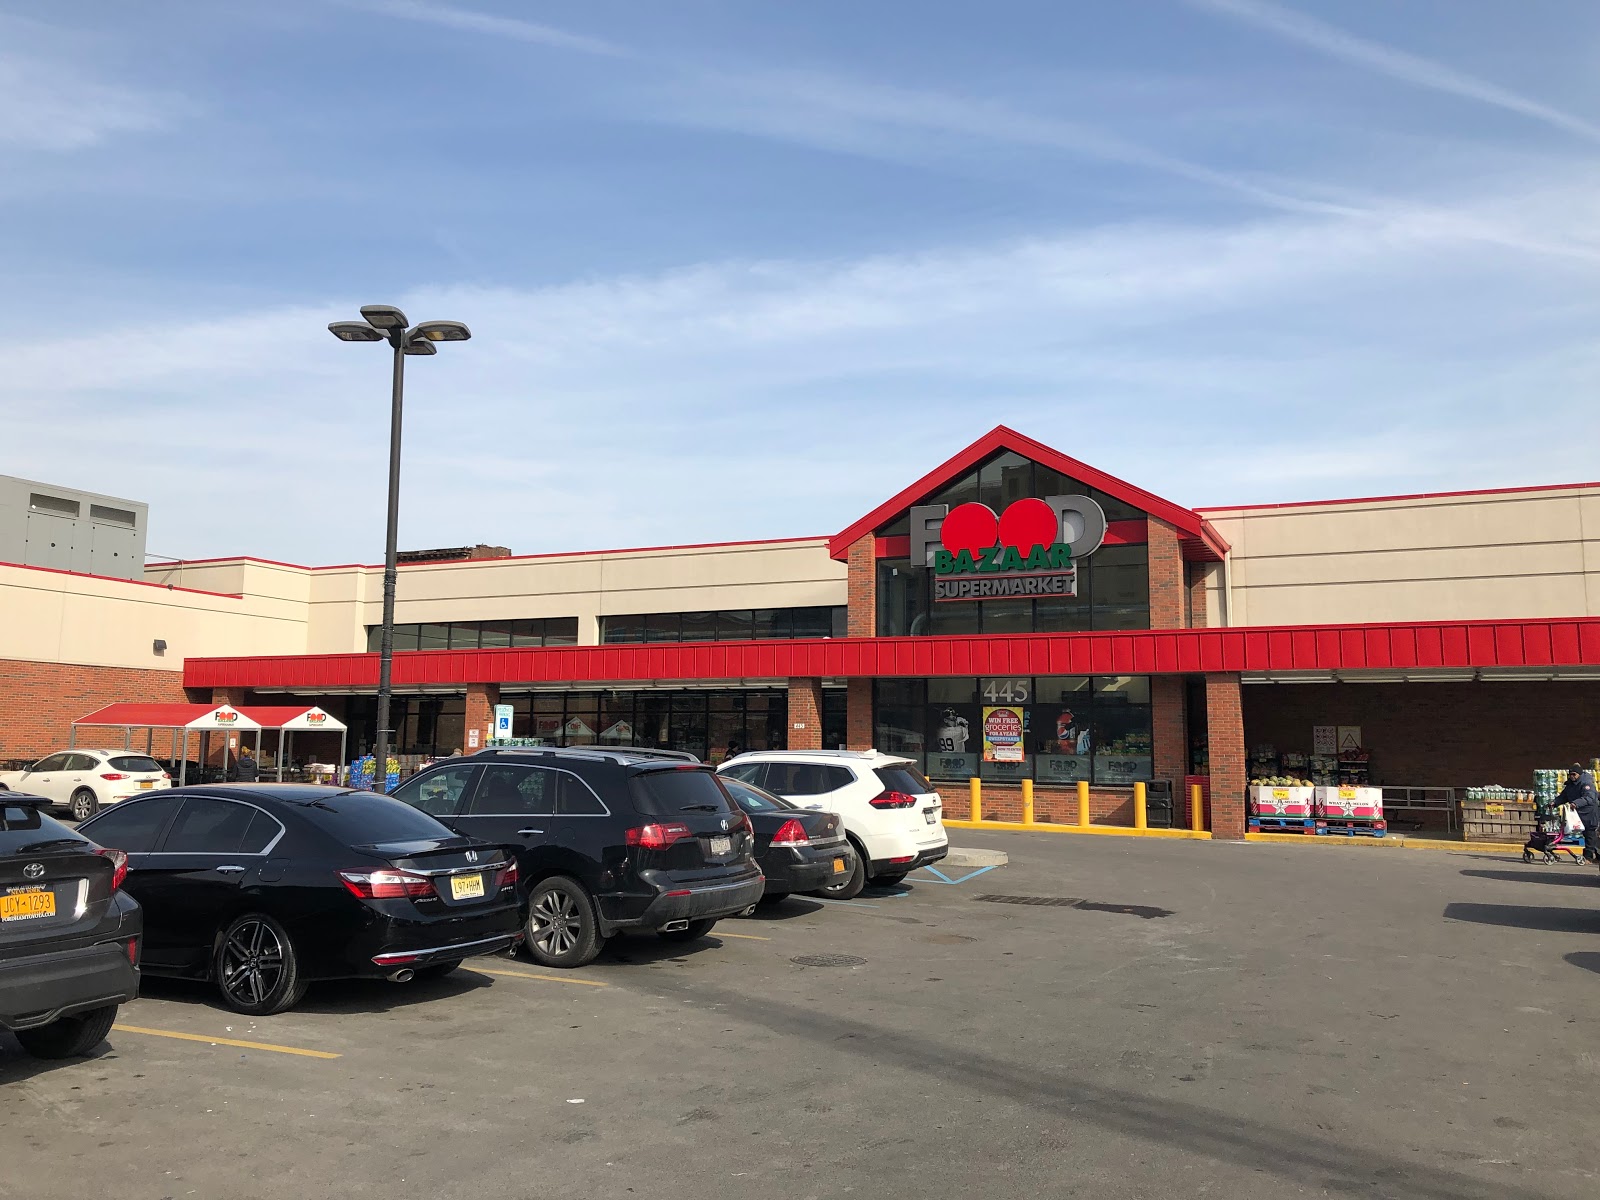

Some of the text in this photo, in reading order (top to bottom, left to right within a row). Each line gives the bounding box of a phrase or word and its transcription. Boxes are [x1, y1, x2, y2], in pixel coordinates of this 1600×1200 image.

[910, 494, 1106, 568] FOOD
[935, 544, 1073, 574] BAZAAR
[935, 576, 1075, 598] SUPERMARKET
[983, 680, 1028, 703] 445
[215, 711, 238, 722] FOOD
[306, 712, 326, 722] FOOD
[984, 723, 1022, 733] groceries
[939, 737, 955, 752] 99
[940, 758, 965, 767] FOOD
[453, 881, 467, 894] L97
[4, 894, 51, 913] JCY 1293
